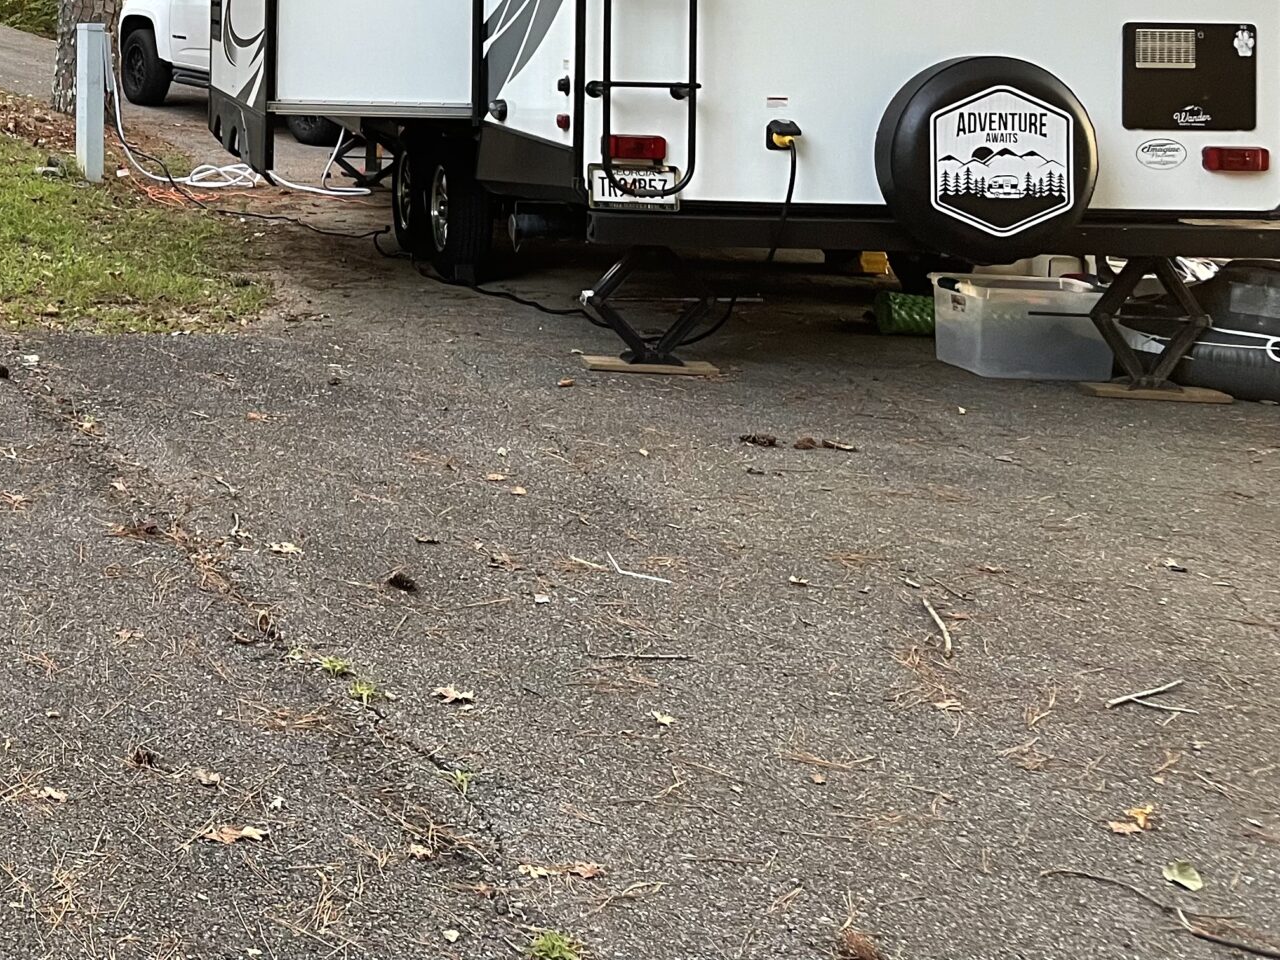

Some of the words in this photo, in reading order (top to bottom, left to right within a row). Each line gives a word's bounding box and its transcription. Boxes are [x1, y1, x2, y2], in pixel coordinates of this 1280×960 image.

[1173, 111, 1212, 123] Wander
[956, 112, 1047, 137] ADVENTURE
[985, 133, 1018, 143] AWAITS
[1146, 145, 1181, 154] Imagine
